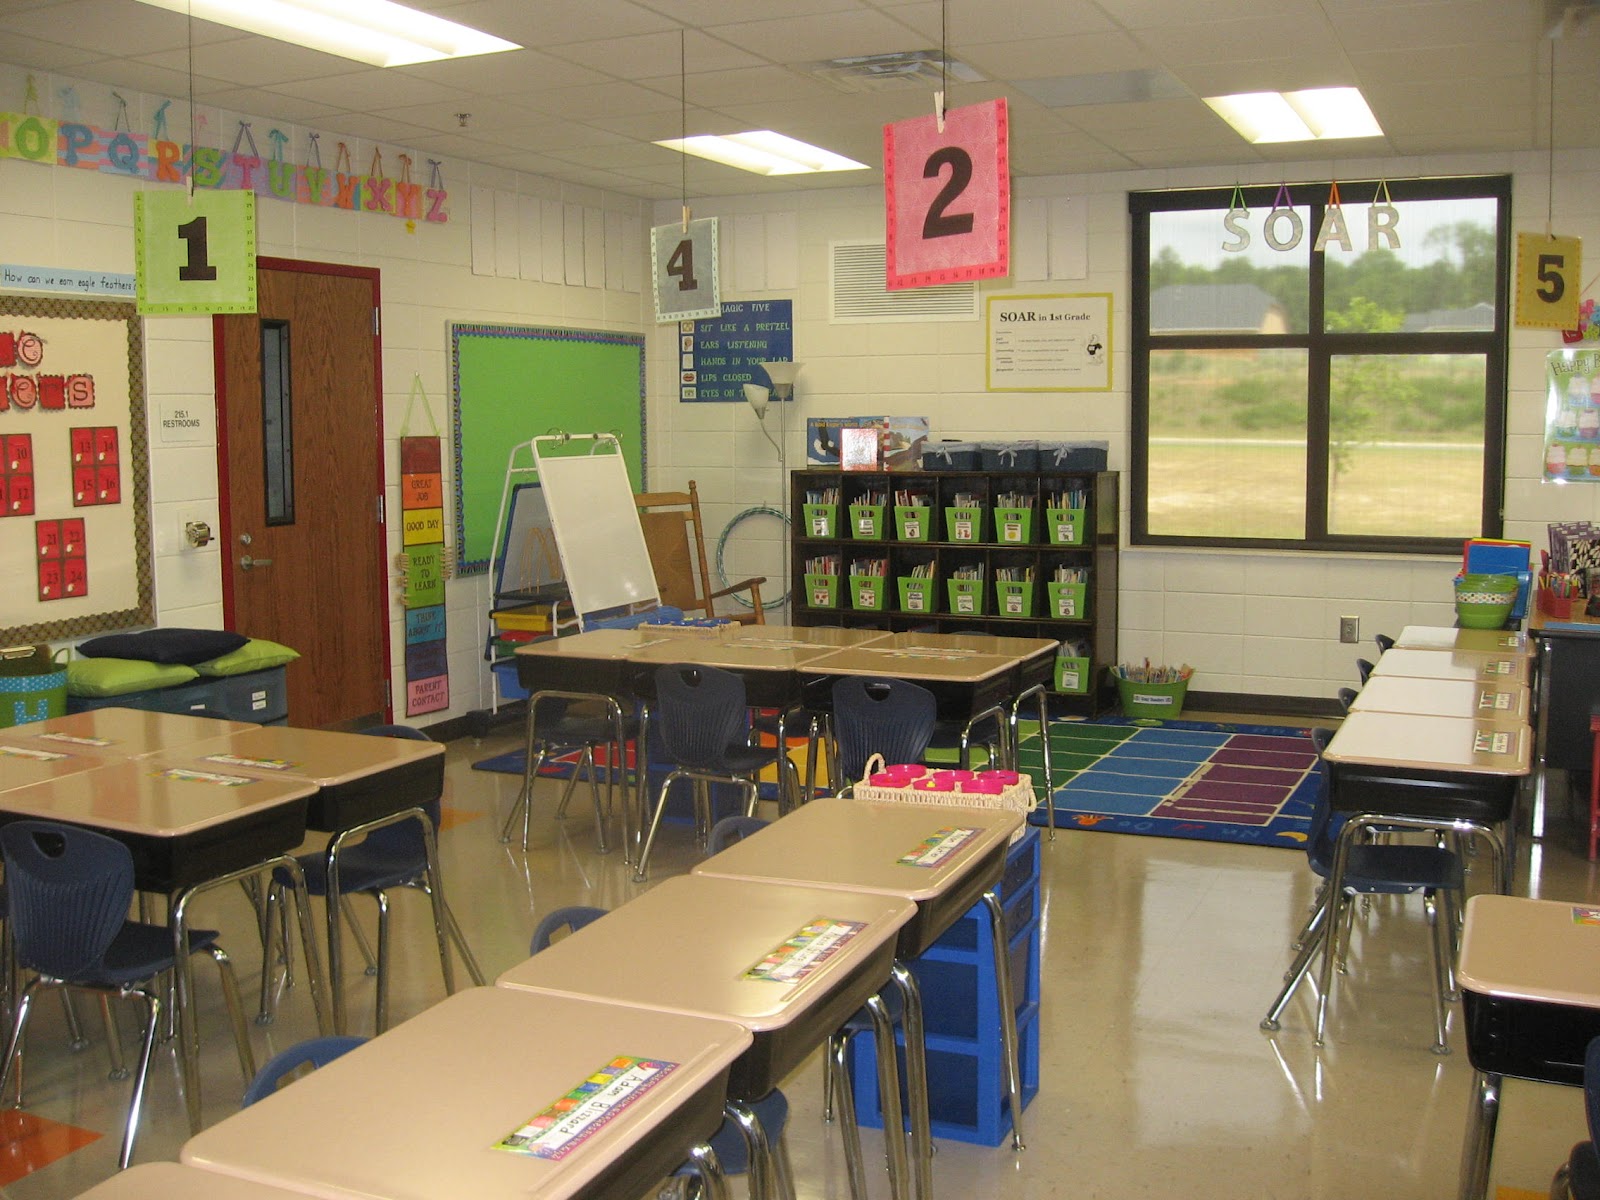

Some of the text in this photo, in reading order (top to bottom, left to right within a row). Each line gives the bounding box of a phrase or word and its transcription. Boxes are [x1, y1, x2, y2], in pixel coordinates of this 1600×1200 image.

[922, 146, 975, 240] 2
[1222, 206, 1401, 252] SOAR
[178, 216, 217, 281] 1
[666, 239, 698, 292] 4
[4, 268, 23, 283] How
[27, 274, 41, 284] can
[45, 277, 54, 285] we
[78, 276, 96, 292] eagle
[1536, 254, 1565, 304] 5
[752, 303, 770, 312] FIVE
[1000, 311, 1036, 322] SOAR
[1050, 313, 1062, 321] 1st
[1064, 313, 1091, 321] Grade
[701, 322, 790, 332] SIT LIKE A PRETZEL
[701, 340, 768, 349] EARS LISTENING
[701, 357, 726, 366] HANDS
[732, 357, 741, 365] IN
[701, 373, 752, 382] LIPS CLOSED
[701, 389, 719, 398] EYES
[724, 389, 735, 397] ON
[163, 419, 200, 428] RESTROOMS
[406, 520, 440, 532] GOOD DAY
[415, 680, 442, 695] PARENT
[411, 691, 446, 707] CONTACT
[559, 1074, 643, 1136] Adam Blizzard
